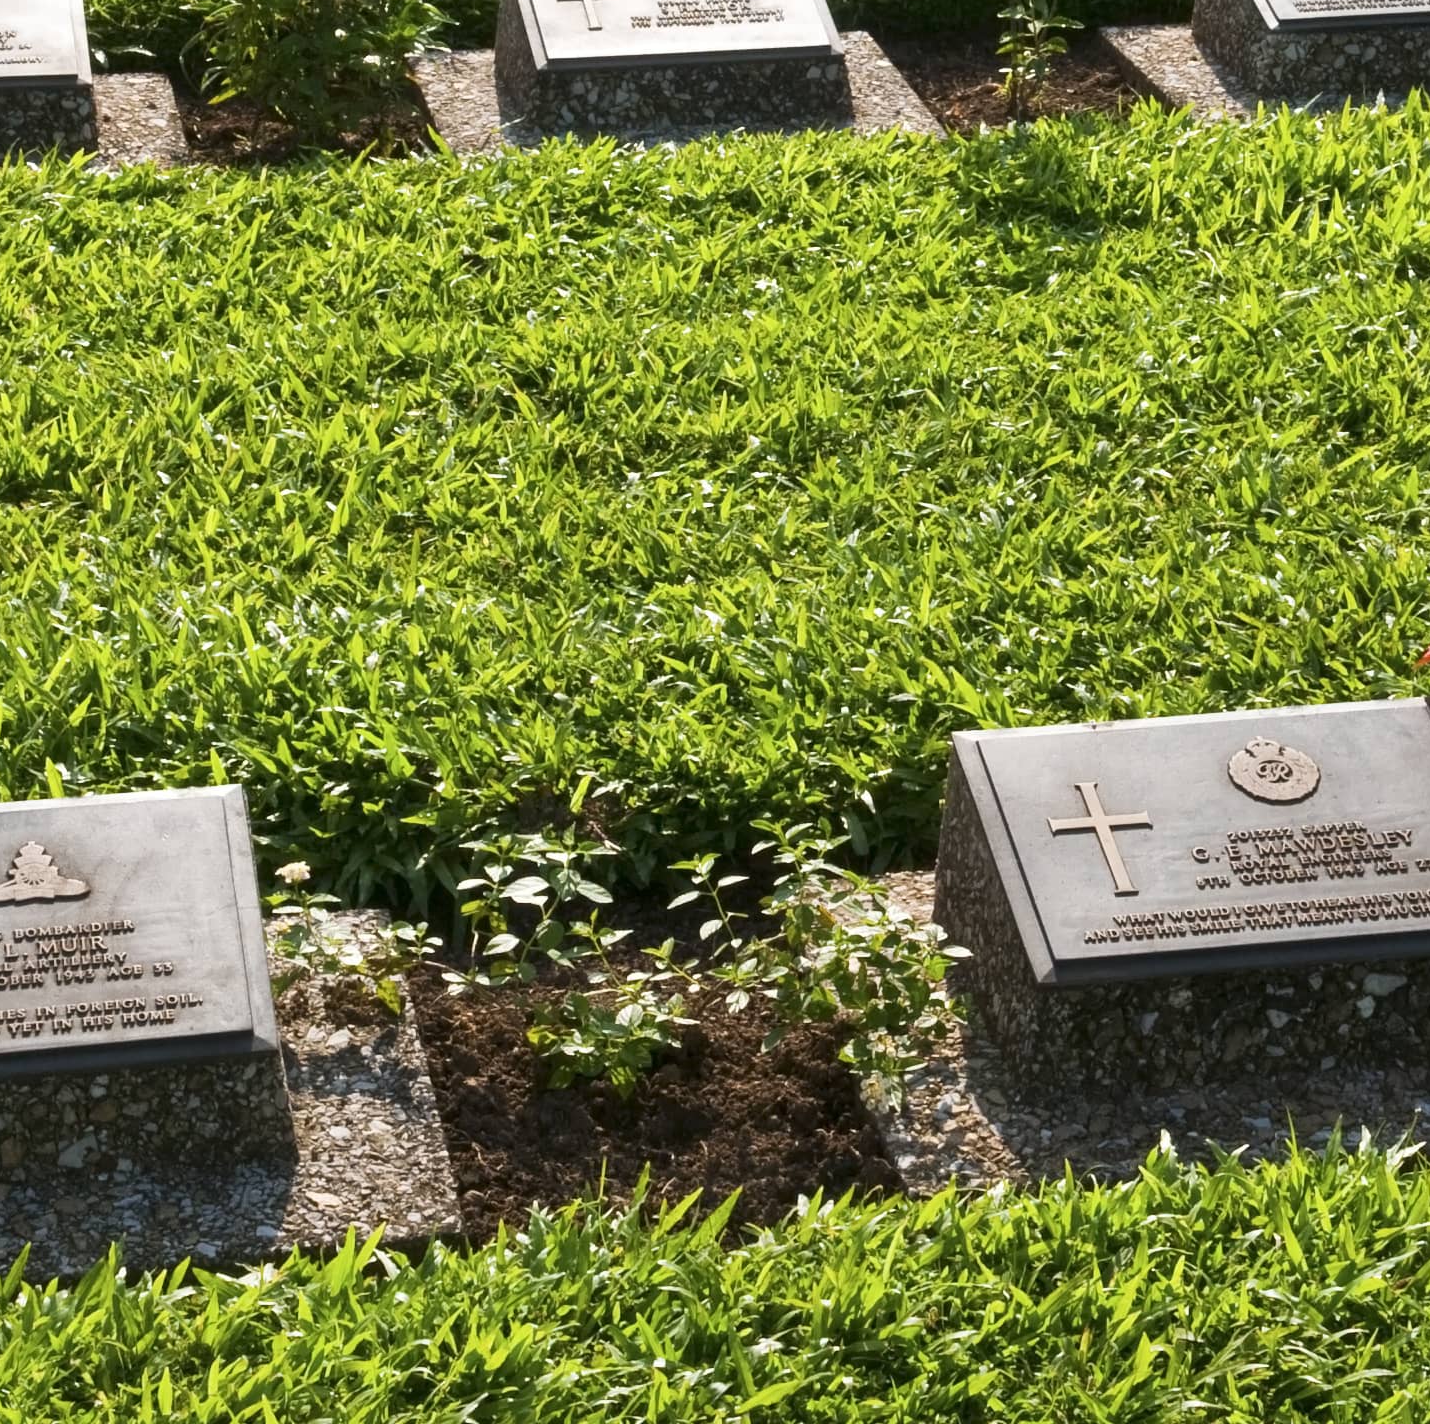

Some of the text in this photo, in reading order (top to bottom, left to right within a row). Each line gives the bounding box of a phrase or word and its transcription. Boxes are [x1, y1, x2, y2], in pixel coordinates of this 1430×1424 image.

[1301, 820, 1367, 836] SAPPER
[1225, 843, 1252, 861] E.
[1255, 829, 1412, 857] MAWDESLEY
[1230, 847, 1392, 875] ROYAL ENGINEERS
[1238, 867, 1319, 887] OCTOBER
[1326, 863, 1365, 880] 1943
[1375, 859, 1408, 876] AGE
[1112, 911, 1165, 928] WHAT
[1168, 905, 1231, 923] WOULD
[1243, 901, 1286, 918] GIVE
[1289, 900, 1311, 914] TO
[1312, 895, 1361, 912] HEAR
[1362, 892, 1393, 909] HIS
[15, 919, 136, 942] BOMBARDIER
[1084, 928, 1121, 945] AND
[1123, 926, 1156, 942] SEE
[1157, 923, 1188, 940] HIS
[1246, 912, 1294, 932] THAT
[1296, 907, 1355, 928] MEANT
[1357, 906, 1380, 923] SO
[37, 935, 108, 957] MUIR
[24, 952, 127, 973] ARTILLERY
[56, 968, 95, 986] 1943
[107, 964, 144, 981] AGE
[153, 961, 174, 976] 33
[36, 1004, 56, 1020] IN
[66, 996, 146, 1018] FOREIGN
[8, 1021, 43, 1039] YET
[52, 1017, 73, 1035] IN
[82, 1013, 114, 1032] HIS
[122, 1008, 176, 1027] HOME
